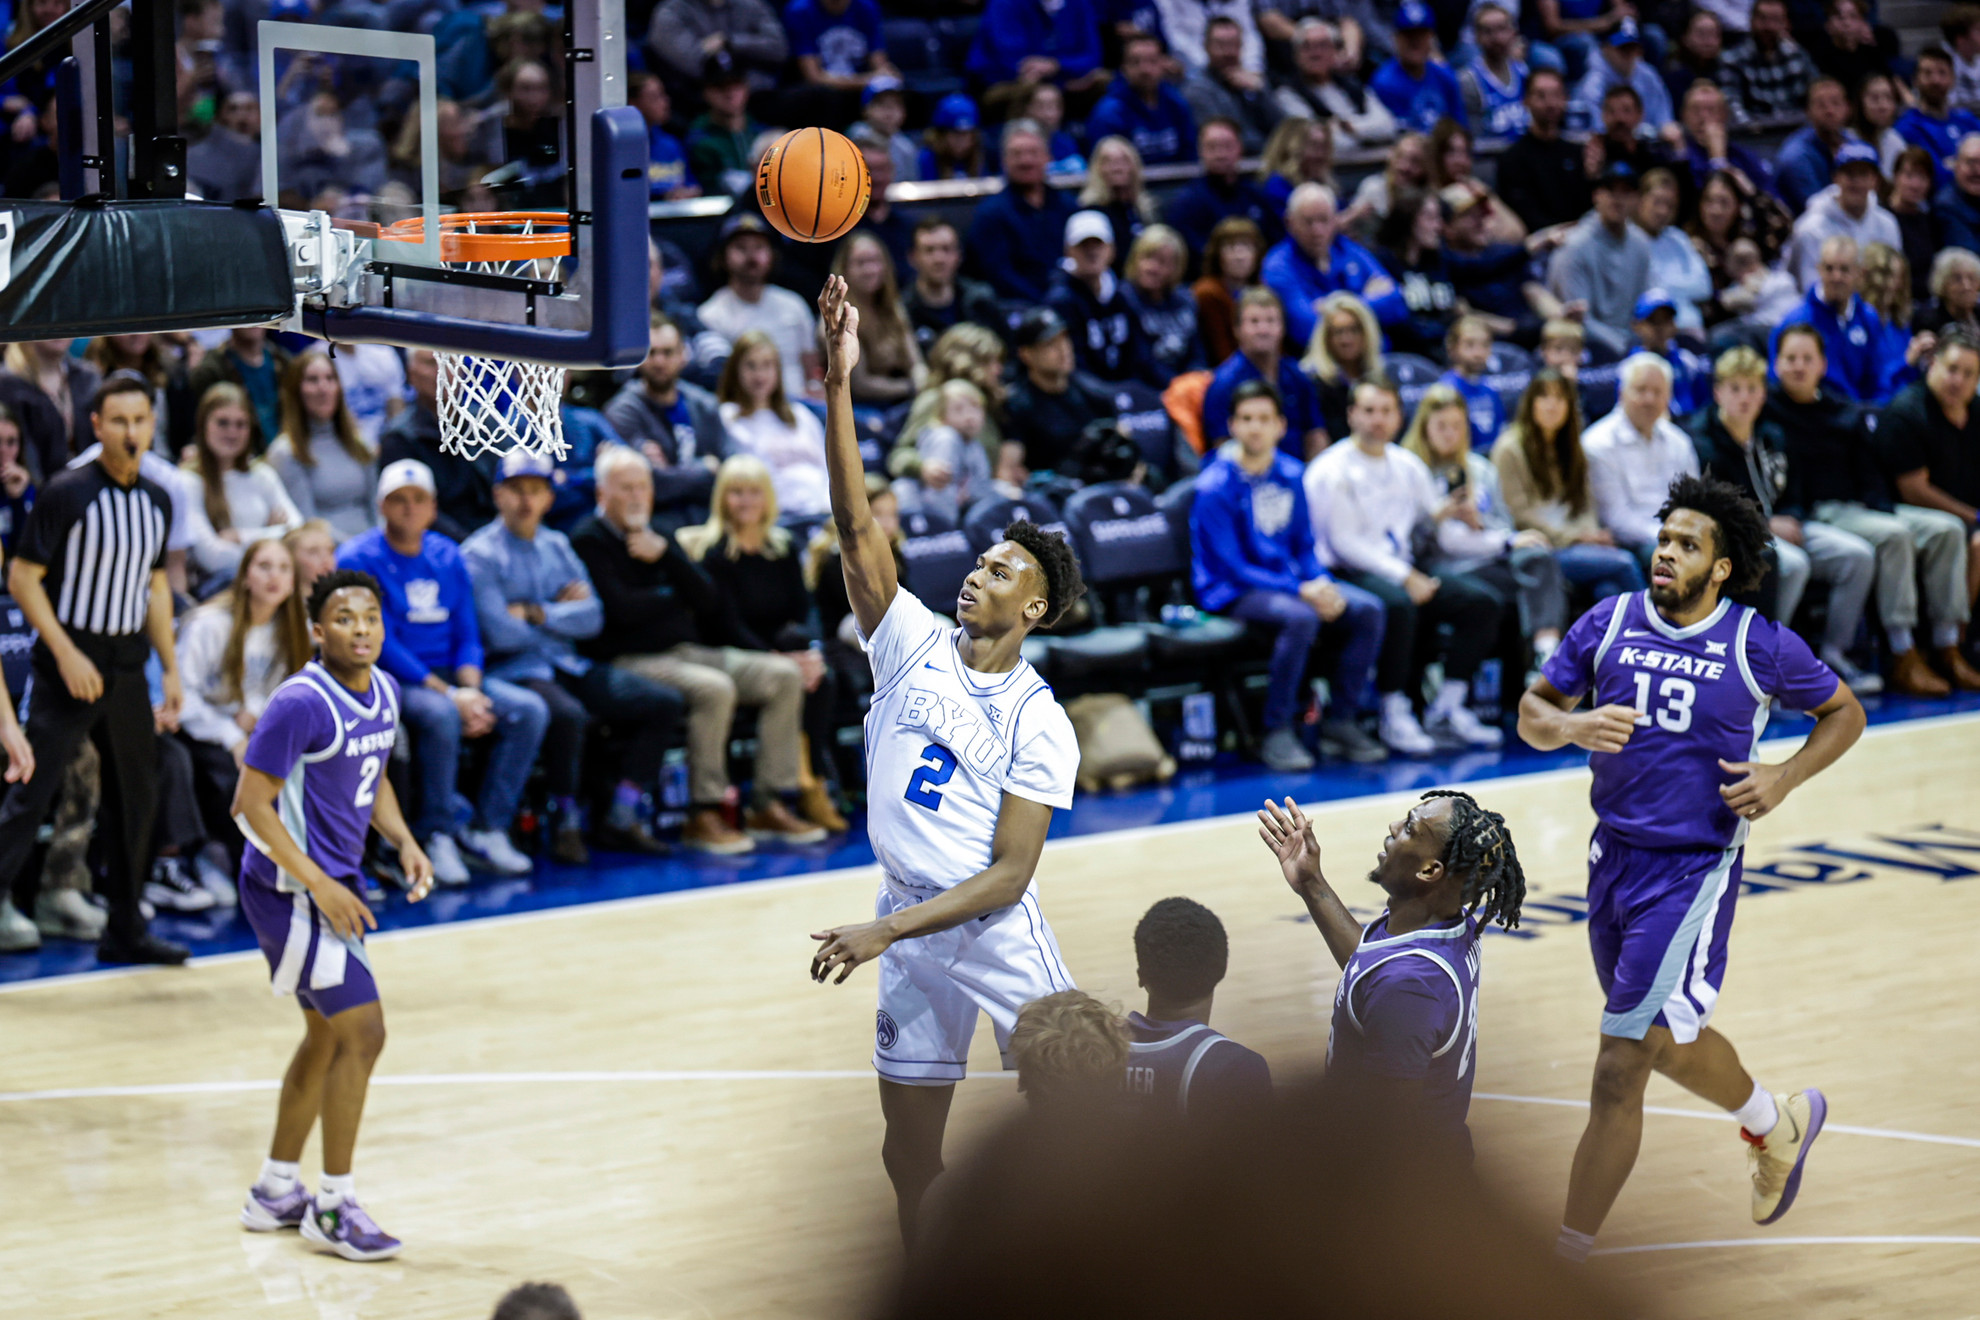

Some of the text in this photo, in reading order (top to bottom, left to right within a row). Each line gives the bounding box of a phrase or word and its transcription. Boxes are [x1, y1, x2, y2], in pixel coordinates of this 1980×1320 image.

[1618, 646, 1726, 680] K-STATE
[1633, 671, 1696, 733] 13
[896, 688, 1008, 776] BYU
[354, 755, 380, 808] 2
[904, 742, 958, 812] 2
[1126, 1066, 1155, 1094] TER
